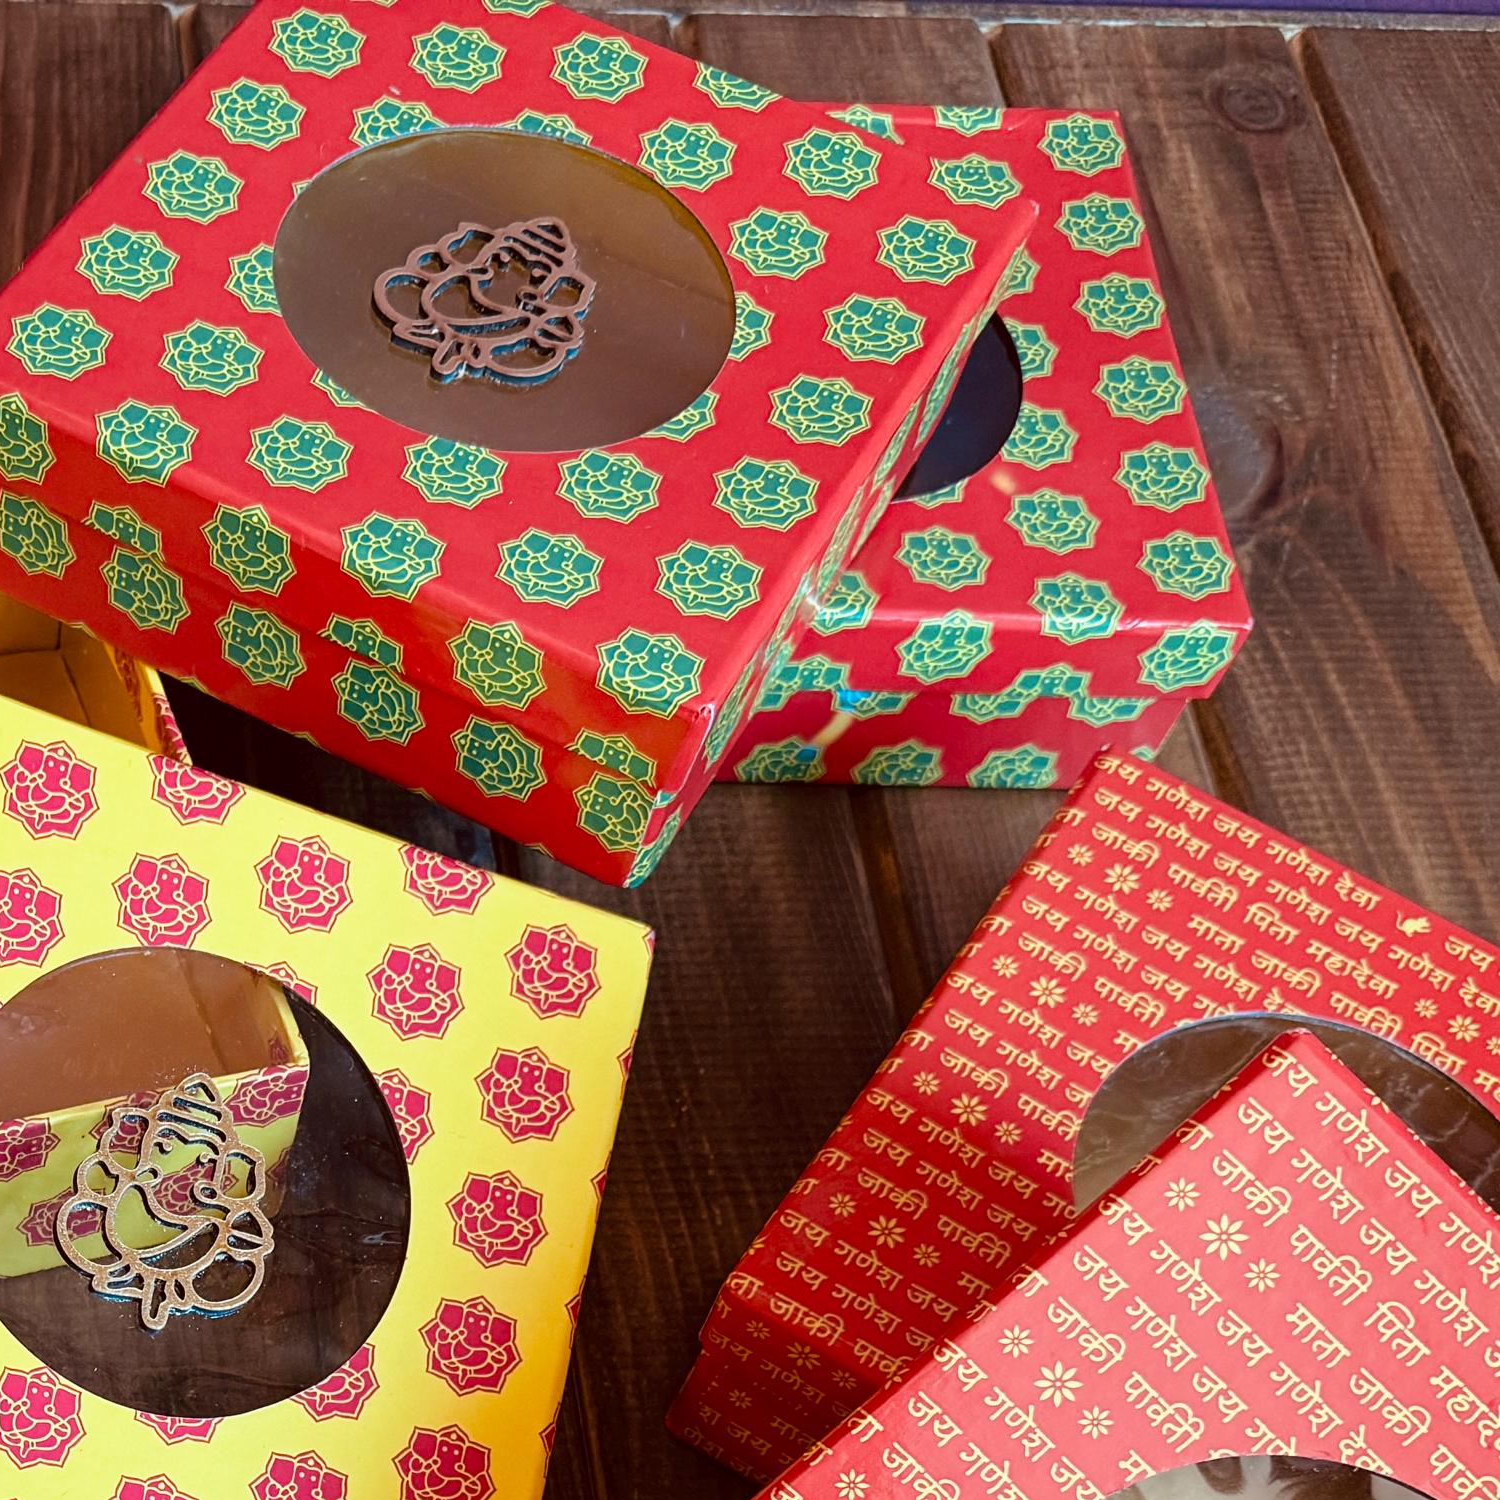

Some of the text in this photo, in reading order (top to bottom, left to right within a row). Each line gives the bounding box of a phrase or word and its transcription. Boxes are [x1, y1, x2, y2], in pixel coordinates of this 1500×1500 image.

[1091, 822, 1161, 869] जाकी
[1243, 901, 1300, 945] पिता
[1305, 939, 1400, 999] महादेवा
[1094, 755, 1496, 973] जय गणेश जय गणेश देवा जय
[1094, 786, 1143, 823] जय
[1145, 815, 1212, 860] गणेश
[1213, 852, 1264, 888] जय
[1265, 879, 1333, 926] गणेश
[1334, 916, 1386, 954] जय
[1387, 944, 1456, 993] गणेश
[1017, 931, 1088, 982] जाकी
[1021, 895, 1071, 933] जय
[1072, 925, 1139, 974] गणेश
[1140, 965, 1191, 1003] जय
[1023, 861, 1260, 1001] जय गणेश जय गणेश
[1187, 914, 1246, 955] माता
[1251, 949, 1322, 997] जाकी
[943, 1008, 995, 1048] जय
[995, 1040, 1064, 1090] गणेश
[947, 971, 997, 1007] जय
[997, 998, 1066, 1050] गणेश
[939, 1046, 1011, 1099] जाकी
[1264, 1043, 1319, 1098] जय
[1315, 1091, 1390, 1168] गणेश
[1384, 1160, 1443, 1218] जय
[857, 1167, 930, 1221] जाकी
[862, 1127, 914, 1168] जय
[915, 1160, 984, 1212] गणेश
[986, 1203, 1038, 1243] जय
[866, 1087, 915, 1125] जय
[917, 1116, 987, 1169] गणेश
[987, 1160, 1040, 1200] जय
[779, 1209, 831, 1248] जय
[833, 1240, 904, 1292] गणेश
[906, 1282, 959, 1323] जय
[1212, 1148, 1293, 1227] जाकी
[1290, 1223, 1373, 1306] पार्वती
[1363, 1300, 1432, 1367] पिता
[1237, 1096, 1295, 1155] जय
[1290, 1147, 1365, 1225] गणेश
[1359, 1217, 1418, 1276] जय
[1413, 1268, 1490, 1348] गणेश
[768, 1291, 847, 1347] जाकी
[775, 1250, 829, 1292] जय
[830, 1282, 903, 1335] गणेश
[1072, 1244, 1130, 1302] जय
[1125, 1295, 1198, 1373] गणेश
[1192, 1365, 1249, 1424] जय
[1098, 1193, 1155, 1246] जय
[1149, 1239, 1223, 1317] गणेश
[1216, 1309, 1274, 1368] जय
[1269, 1361, 1344, 1439] गणेश
[907, 1390, 964, 1448] जय
[932, 1338, 989, 1393] जय
[983, 1386, 1056, 1463] गणेश
[1047, 1296, 1205, 1453] जाकी पार्वती
[1285, 1302, 1352, 1369] माता
[1349, 1367, 1432, 1447] जाकी
